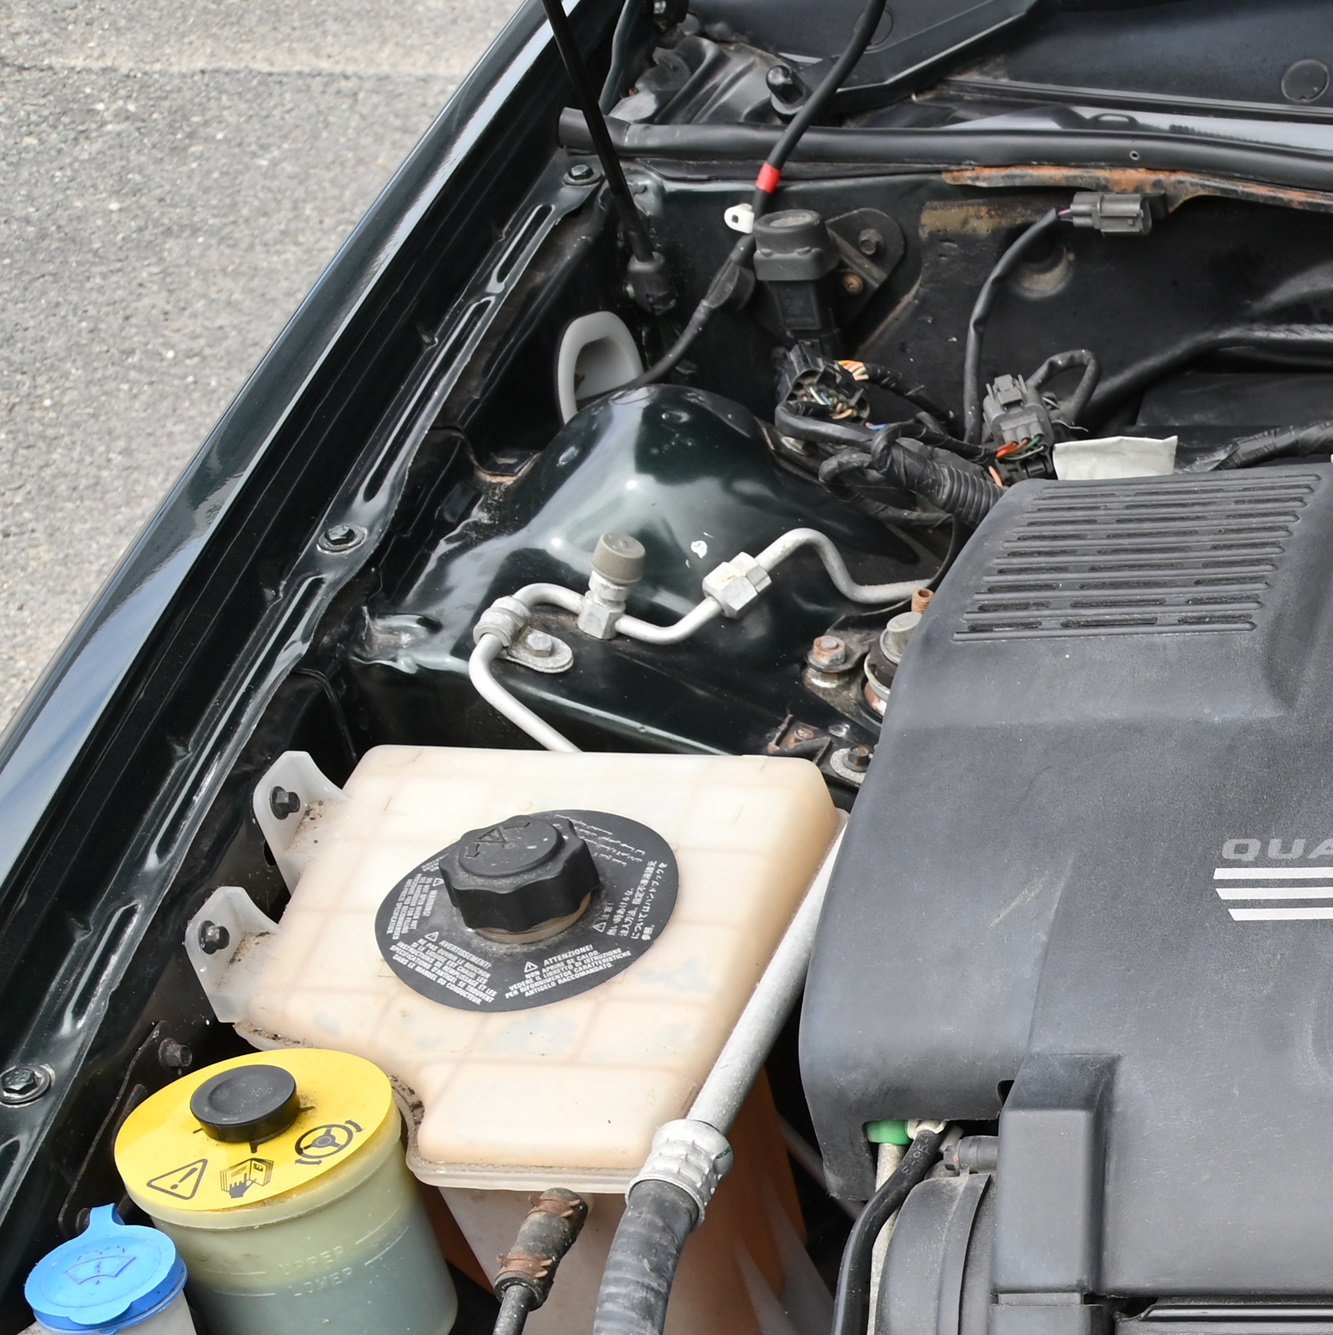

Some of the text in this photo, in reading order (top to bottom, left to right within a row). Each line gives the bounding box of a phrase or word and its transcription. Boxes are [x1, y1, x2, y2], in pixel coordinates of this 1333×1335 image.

[544, 944, 593, 966] ATTENZIONE!
[509, 979, 534, 991] VEDERE
[543, 965, 573, 978] LIBRETTO
[584, 948, 622, 965] ISTRUZIONE
[525, 970, 540, 979] NON
[505, 991, 519, 999] PER
[525, 982, 556, 997] ANTIGELO
[280, 1246, 343, 1275] UPPER
[289, 1267, 352, 1296] LOWER
